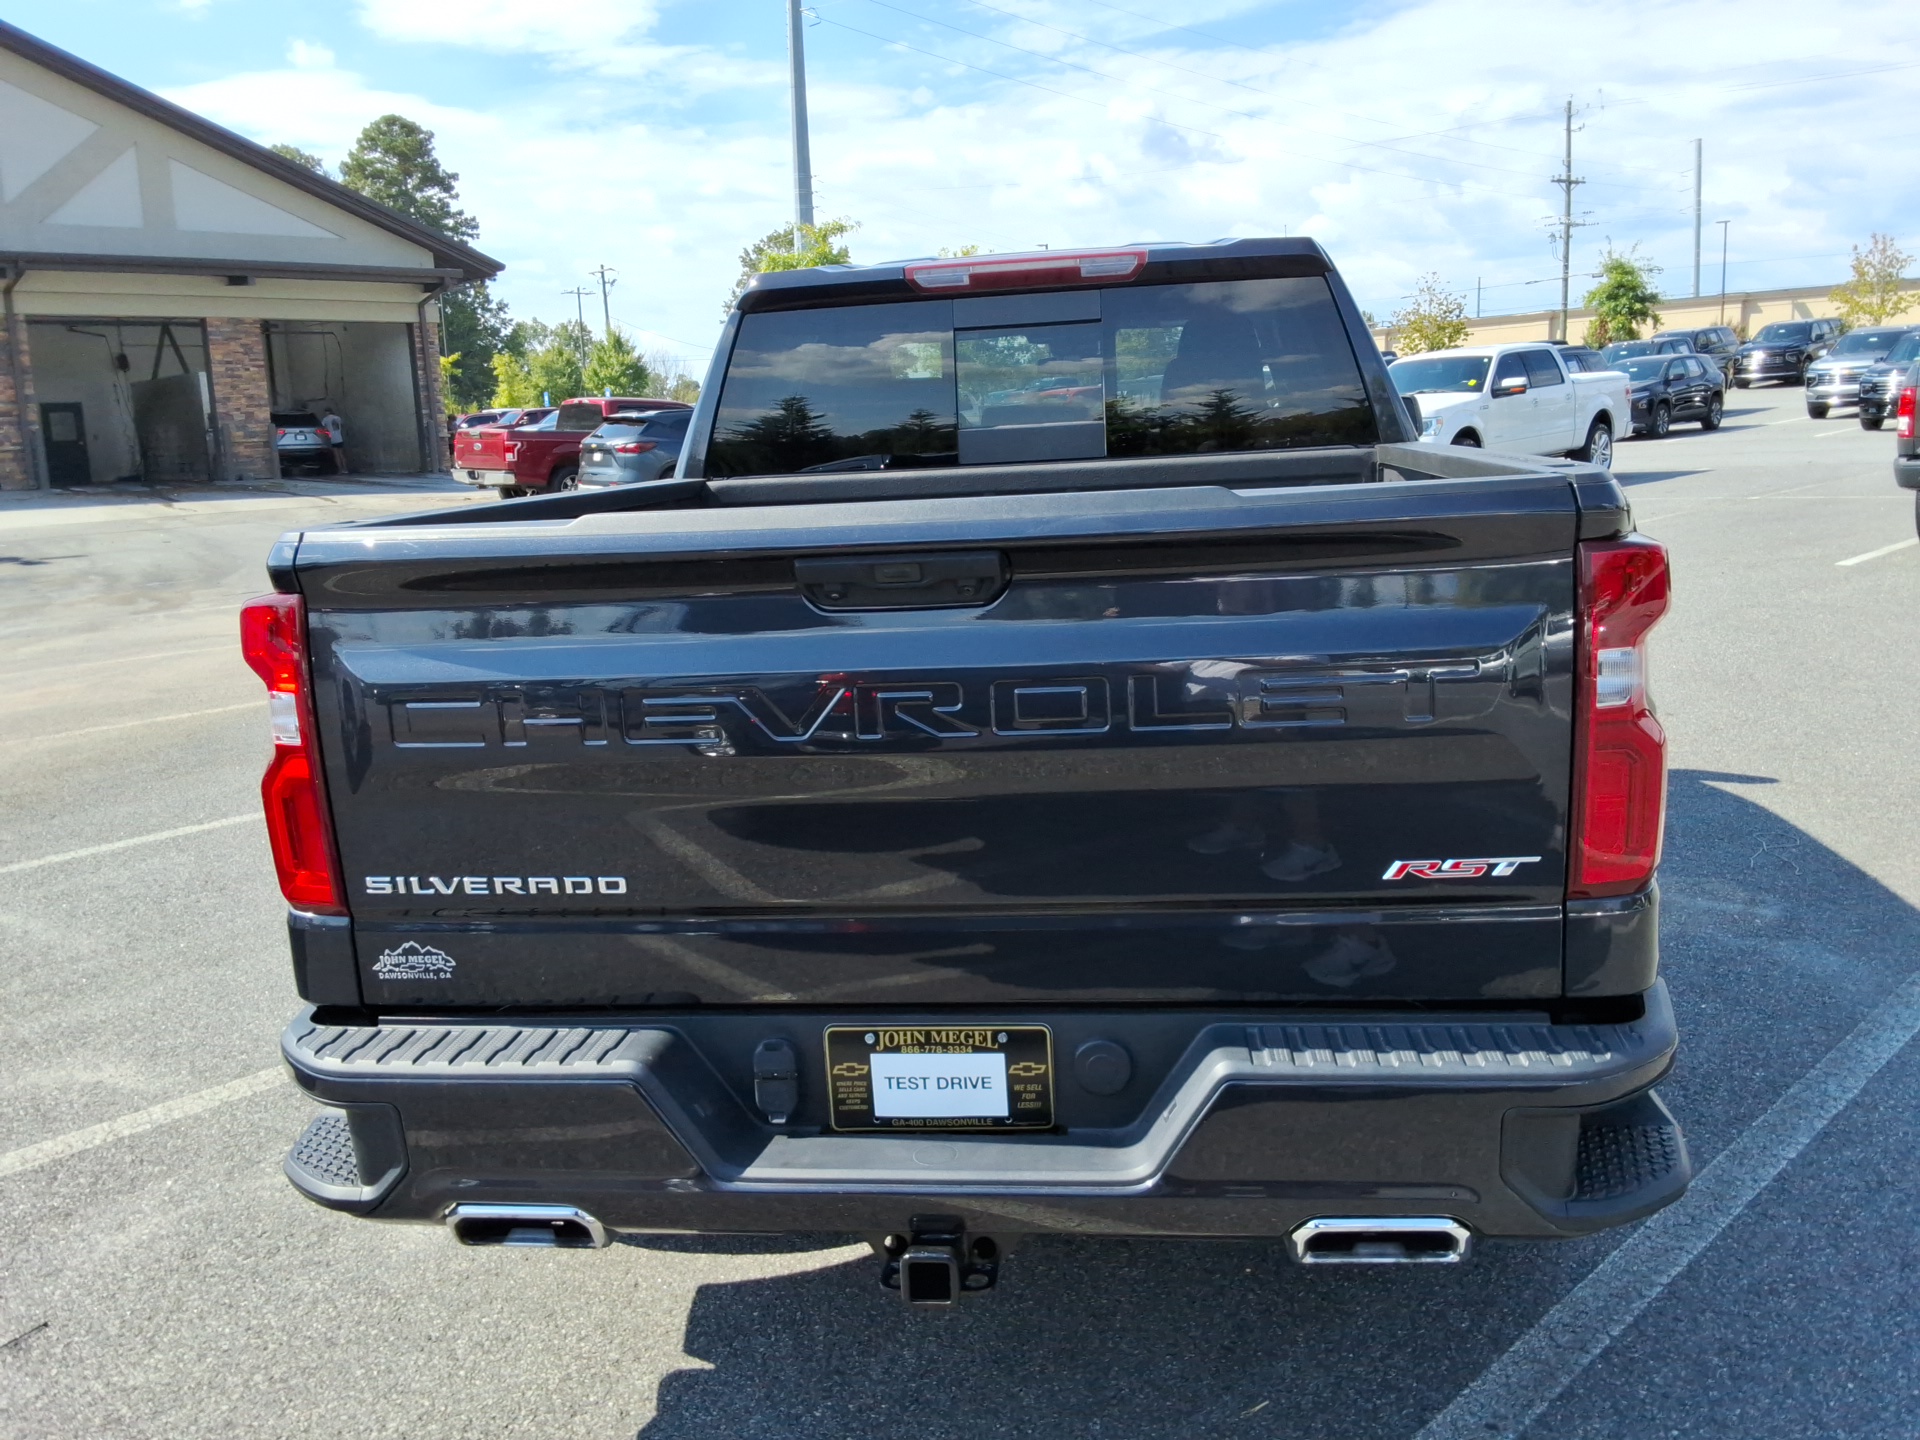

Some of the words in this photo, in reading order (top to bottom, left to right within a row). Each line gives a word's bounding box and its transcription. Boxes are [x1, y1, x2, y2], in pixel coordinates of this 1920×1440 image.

[390, 658, 1482, 748] CHEVROLET
[1382, 856, 1542, 880] RST
[365, 876, 628, 895] SILVERADO
[379, 955, 406, 968] JOHN
[408, 955, 446, 965] MEGEL
[378, 972, 437, 980] DAWSONVILLE,
[876, 1030, 925, 1052] JOHN
[930, 1030, 999, 1049] MEGEL
[900, 1045, 973, 1054] 866-778-3334
[884, 1076, 930, 1090] TEST
[936, 1076, 992, 1090] DRIVE
[891, 1117, 924, 1127] GA-400
[925, 1117, 993, 1127] DAWSONVILLE
